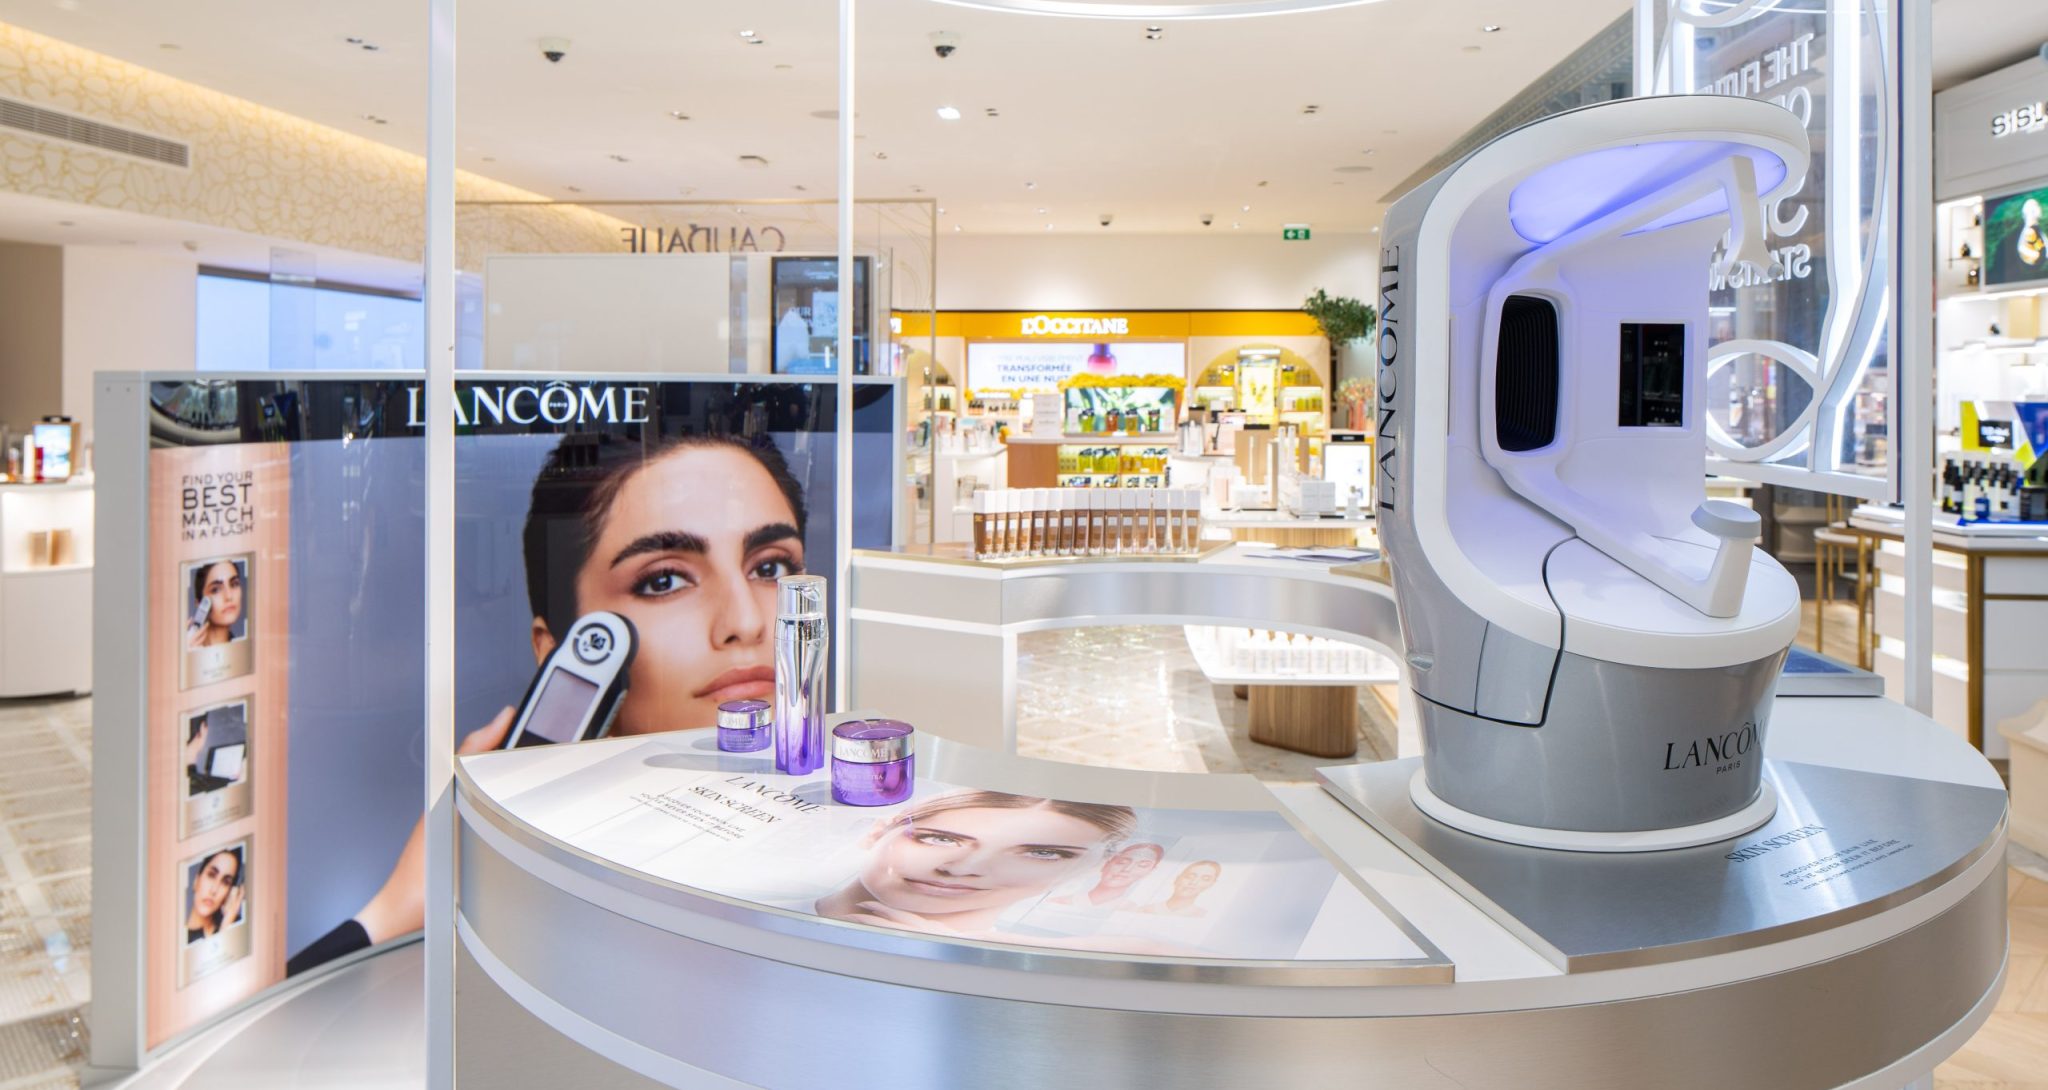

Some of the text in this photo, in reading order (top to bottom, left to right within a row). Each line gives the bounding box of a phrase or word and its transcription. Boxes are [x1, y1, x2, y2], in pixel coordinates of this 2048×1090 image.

[997, 362, 1072, 372] TRANSFORMÉE
[1001, 375, 1016, 383] EN
[182, 470, 253, 486] FIND YOUR
[182, 482, 253, 510] BEST
[182, 505, 254, 529] MATCH
[212, 522, 254, 537] FLASH
[1716, 760, 1742, 775] PARIS
[688, 786, 781, 824] SKIN SCREEN
[1724, 823, 1828, 864] SKIN SCREEN
[1869, 839, 1901, 854] BEFORE
[1780, 860, 1820, 878] DISCOVER
[1820, 850, 1843, 864] YOUR
